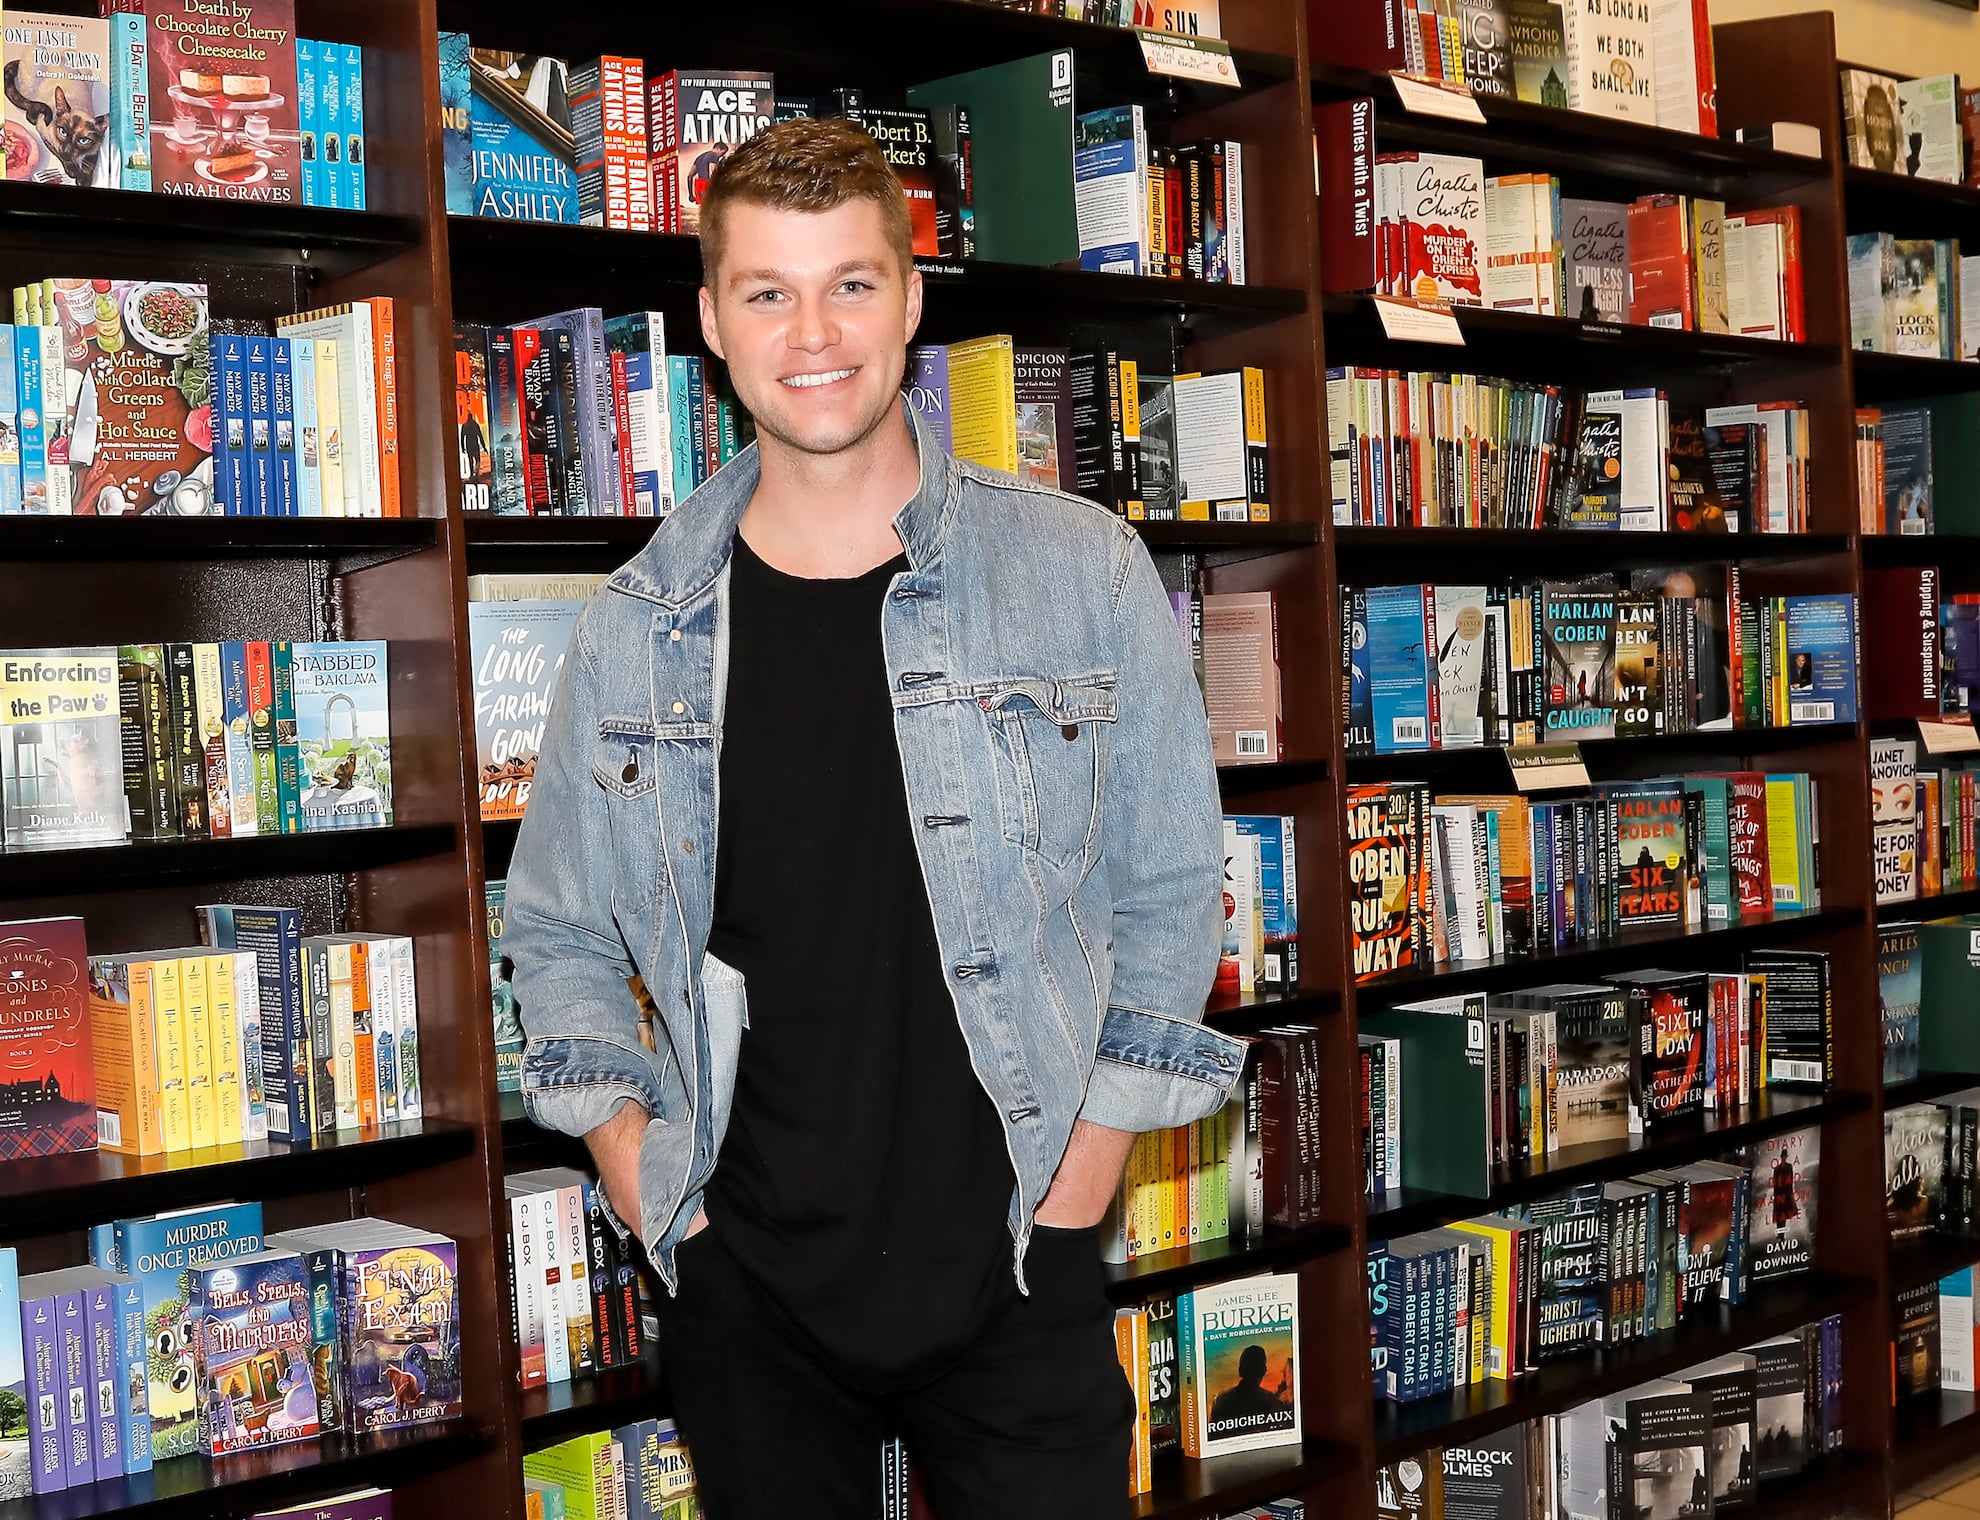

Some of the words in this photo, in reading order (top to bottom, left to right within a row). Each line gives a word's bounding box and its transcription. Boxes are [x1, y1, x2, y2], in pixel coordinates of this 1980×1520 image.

[184, 0, 230, 16] Death
[232, 3, 251, 20] by
[1588, 0, 1601, 15] AS
[1607, 3, 1633, 20] LONG
[1638, 9, 1649, 23] AS
[155, 14, 230, 38] Chocolate
[234, 22, 287, 45] Cherry
[1165, 9, 1197, 35] SUN
[5, 28, 33, 46] ONE
[35, 29, 76, 47] TASTE
[177, 35, 266, 60] Cheesecake
[1597, 35, 1613, 53] WE
[1619, 38, 1644, 58] BOTH
[34, 50, 61, 66] TOO
[64, 52, 101, 70] MANY
[131, 43, 143, 67] BAT
[604, 61, 621, 70] ACE
[1057, 60, 1065, 79] B
[36, 70, 56, 79] Debra
[58, 72, 66, 80] H.
[68, 73, 100, 82] Goldstein
[132, 79, 140, 93] THE
[681, 79, 692, 87] NEW
[722, 80, 752, 88] BESTSELLING
[753, 81, 770, 89] AUTHOR
[1592, 72, 1624, 93] SHALL
[1629, 78, 1649, 97] LIVE
[604, 70, 623, 132] ATKINS
[698, 91, 757, 112] ACE
[132, 94, 144, 138] BELFRY
[1353, 102, 1367, 152] Stories
[472, 151, 568, 184] JENNIFER
[607, 156, 624, 164] THE
[1228, 146, 1236, 184] LINWOOD
[1354, 156, 1370, 182] with
[1417, 166, 1477, 193] Agatha
[162, 181, 220, 198] SARAH
[225, 185, 291, 201] GRAVES
[607, 165, 627, 230] RANGER
[1354, 188, 1366, 196] a
[479, 190, 566, 222] ASHLEY
[1229, 185, 1238, 221] BARCLAY
[1417, 197, 1478, 221] Christie
[1355, 200, 1371, 237] Twist
[1573, 216, 1625, 241] Agatha
[1423, 235, 1466, 247] MURDER
[1426, 246, 1441, 254] ON
[1443, 247, 1465, 256] THE
[1433, 255, 1469, 265] ORIENT
[1573, 242, 1624, 263] Christie
[1433, 264, 1474, 276] EXPRESS
[1575, 266, 1623, 287] ENDLESS
[384, 333, 392, 348] The
[111, 353, 162, 370] Murder
[1107, 352, 1116, 366] THE
[95, 375, 115, 387] with
[117, 371, 177, 387] Collard
[233, 371, 242, 389] MAY
[385, 352, 394, 389] Bengal
[226, 371, 234, 412] MURDER
[1108, 368, 1117, 400] SECOND
[108, 388, 164, 406] Greens
[234, 391, 243, 411] DAY
[128, 408, 146, 421] and
[386, 390, 394, 433] Identity
[1110, 402, 1118, 422] RIDER
[98, 424, 130, 439] Hot
[133, 426, 177, 440] Sauce
[1112, 431, 1120, 452] ALEX
[102, 452, 122, 460] A.L.
[125, 451, 177, 461] HERBERT
[1920, 570, 1935, 619] Gripping
[1548, 604, 1613, 619] HARLAN
[501, 627, 529, 644] THE
[1554, 625, 1606, 642] COBEN
[6, 663, 111, 682] Enforcing
[293, 655, 376, 672] STABBED
[478, 644, 545, 686] LONG
[1924, 631, 1936, 699] Suspenseful
[314, 672, 377, 686] BAKLAVA
[11, 699, 41, 718] the
[49, 696, 87, 713] Paw
[1547, 709, 1613, 728] CAUGHT
[1512, 758, 1523, 766] Our
[1525, 756, 1540, 764] Staff
[1541, 755, 1580, 764] Recommends
[1872, 750, 1904, 764] JANET
[331, 802, 383, 817] Kashian
[30, 814, 68, 827] Diane
[71, 813, 107, 825] Kelly
[1619, 823, 1675, 840] COBEN
[1890, 835, 1914, 852] FOR
[1876, 856, 1900, 874] THE
[1631, 868, 1663, 887] SIX
[1476, 901, 1486, 939] HOME
[13, 954, 54, 969] MacRae
[1672, 998, 1688, 1006] THE
[1657, 1009, 1702, 1032] SIXTH
[1666, 1034, 1694, 1055] DAY
[1653, 1071, 1703, 1090] CATHERINE
[1653, 1088, 1702, 1109] COULTER
[1768, 1136, 1804, 1151] DIARY
[520, 1204, 530, 1231] C.J.
[166, 1220, 228, 1247] MURDER
[138, 1251, 183, 1273] ONCE
[188, 1236, 259, 1263] REMOVED
[522, 1233, 530, 1266] BOX
[1767, 1239, 1798, 1253] DAVID
[1755, 1252, 1807, 1271] DOWNING
[354, 1261, 453, 1296] FINAL
[209, 1288, 253, 1309] BELLS,
[258, 1281, 304, 1301] SPELLS,
[1216, 1294, 1251, 1307] JAMES
[1256, 1292, 1278, 1301] LEE
[249, 1310, 269, 1324] AND
[358, 1299, 450, 1330] EXAM
[599, 1295, 608, 1333] PARADISE
[1202, 1303, 1292, 1332] BURKE
[1904, 1300, 1933, 1318] george
[1405, 1295, 1416, 1346] ROBERT
[212, 1318, 308, 1351] MURDERS
[1229, 1327, 1273, 1337] ROBICHEAUX
[602, 1335, 612, 1365] VALLEY
[1404, 1349, 1414, 1385] CRAIS
[365, 1414, 400, 1426] CAROL
[402, 1411, 410, 1422] J.
[413, 1406, 446, 1419] PERRY
[1208, 1411, 1293, 1433] ROBICHEAUX
[1642, 1416, 1674, 1425] SHERLOCK
[1676, 1414, 1704, 1422] HOLMES
[223, 1434, 257, 1450] CAROL
[259, 1433, 267, 1444] J.
[269, 1427, 304, 1442] PERRY
